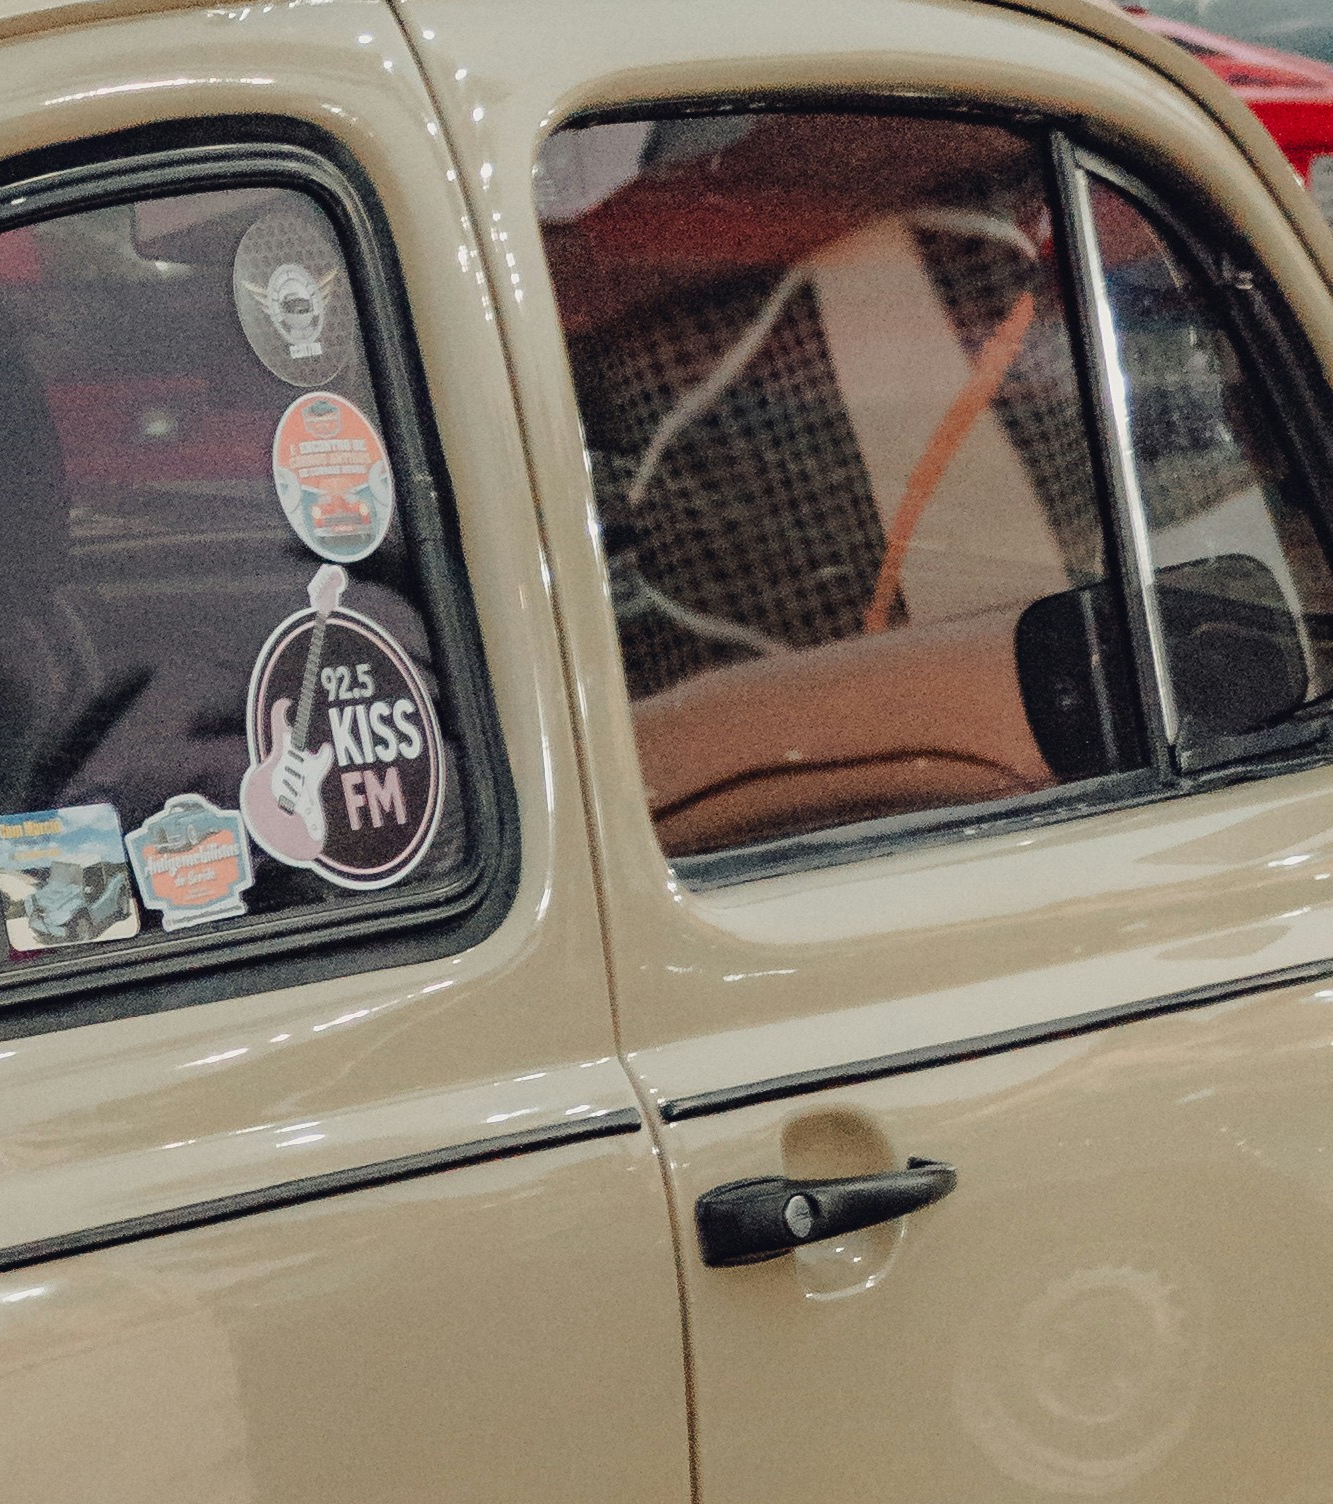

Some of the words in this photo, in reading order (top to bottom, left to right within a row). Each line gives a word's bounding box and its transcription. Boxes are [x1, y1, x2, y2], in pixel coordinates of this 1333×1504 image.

[320, 663, 376, 702] 92.5
[328, 697, 423, 768] KISS
[340, 765, 407, 832] FM
